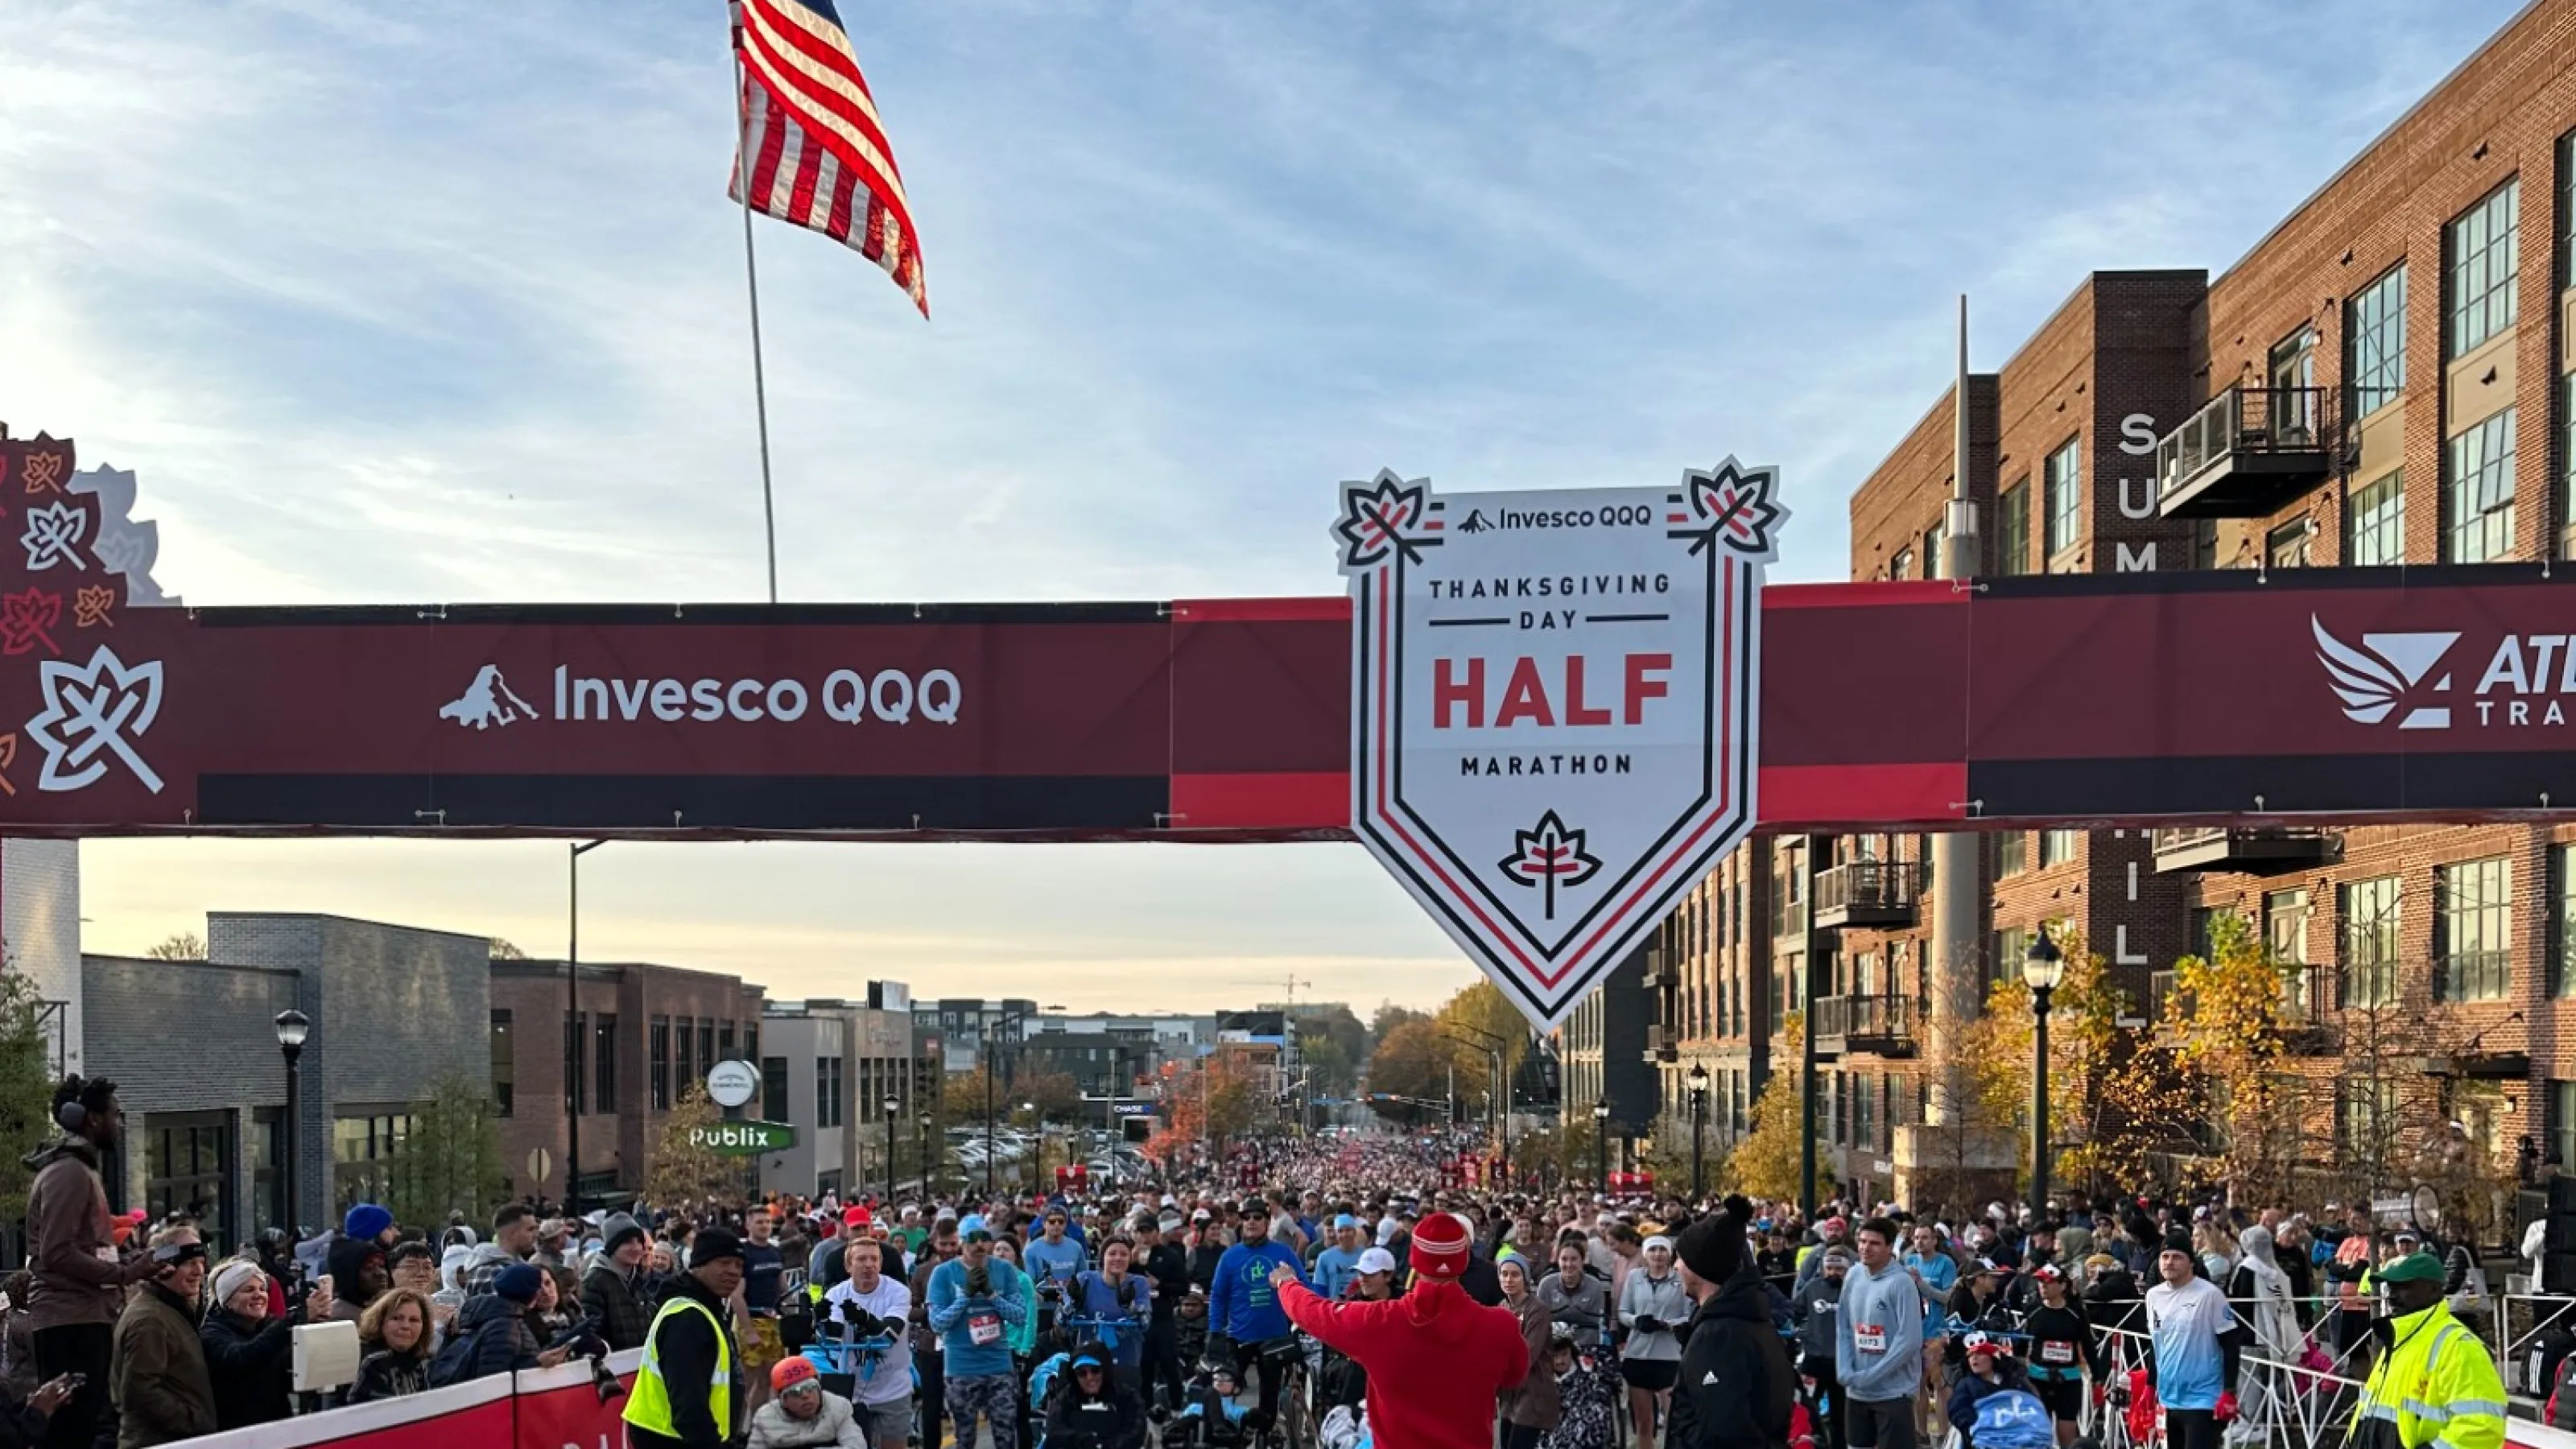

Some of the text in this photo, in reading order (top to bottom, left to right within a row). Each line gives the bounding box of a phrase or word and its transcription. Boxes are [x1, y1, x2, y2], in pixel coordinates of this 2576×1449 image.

[1499, 505, 1652, 530] Invesco QQQ
[1429, 572, 1670, 600] THANKSGIVING
[1520, 609, 1578, 630] DAY
[554, 664, 961, 725] Invesco QQQ
[1433, 654, 1673, 729] HALF
[2475, 699, 2565, 726] TRA
[1461, 754, 1632, 776] MARATHON
[689, 1127, 769, 1146] Publix
